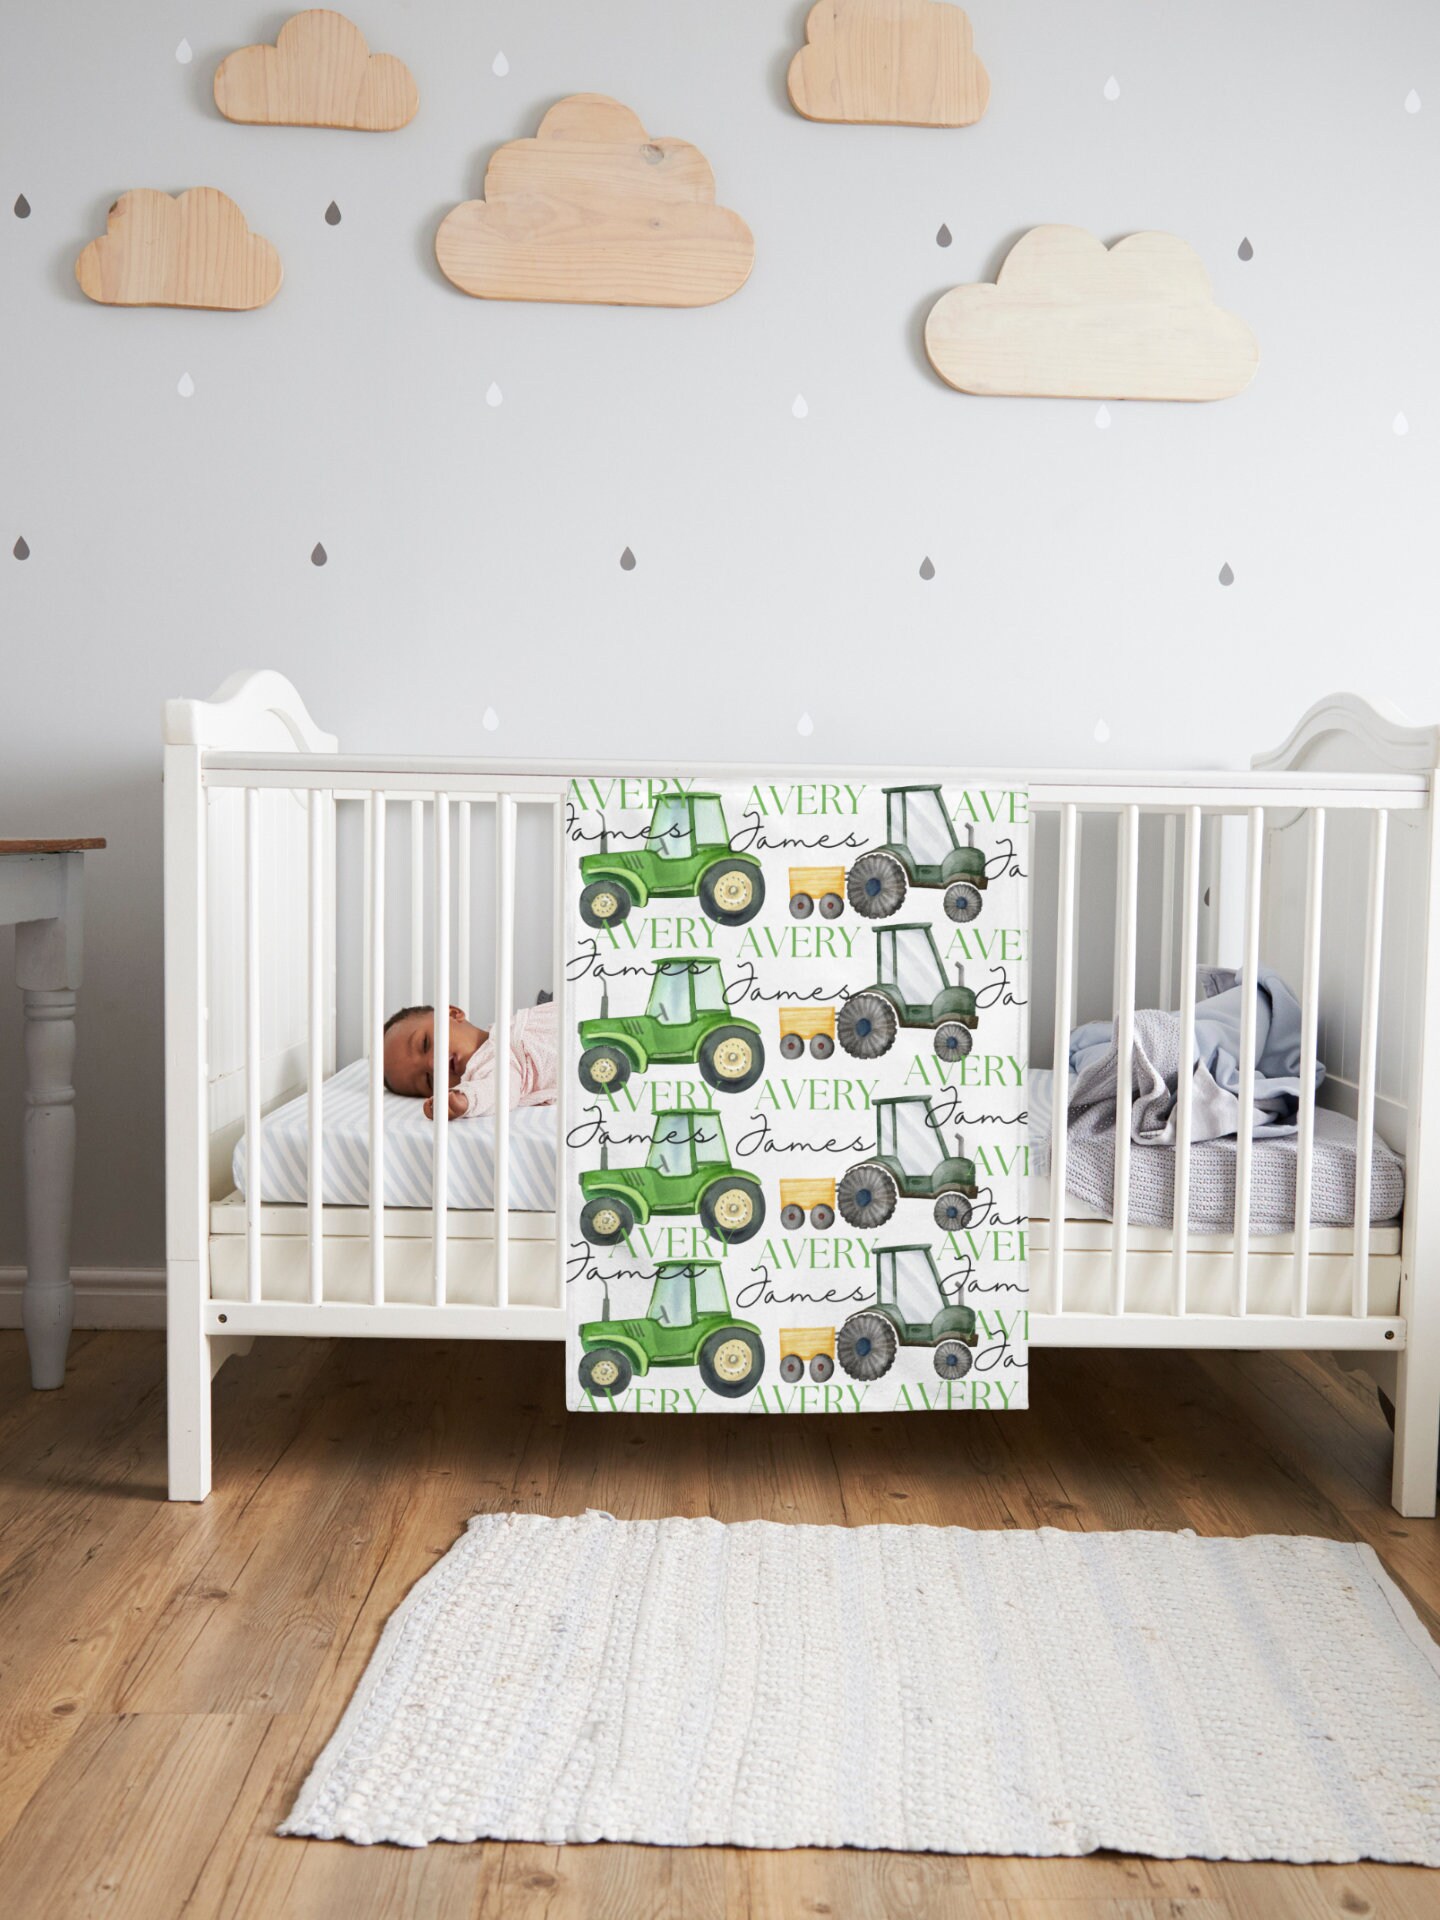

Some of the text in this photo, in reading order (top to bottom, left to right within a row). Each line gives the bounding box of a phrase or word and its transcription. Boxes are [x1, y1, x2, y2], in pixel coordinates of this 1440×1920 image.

[567, 777, 695, 810] AVERY
[743, 784, 866, 816] AVERY
[728, 811, 869, 853] James
[591, 917, 722, 949] AVERY
[736, 926, 861, 958] AVERY
[944, 928, 1028, 961] AVE
[566, 938, 712, 981] James
[722, 961, 851, 1005] James
[904, 1054, 1028, 1087] AVERY
[590, 1080, 722, 1112] AVERY
[754, 1079, 880, 1110] AVERY
[566, 1105, 717, 1148] James
[736, 1113, 876, 1156] James
[608, 1226, 737, 1258] AVERY
[757, 1238, 879, 1269] AVERY
[566, 1241, 706, 1283] James
[736, 1265, 876, 1308] James
[748, 1384, 870, 1414] AVERY
[893, 1380, 1019, 1411] AVERY
